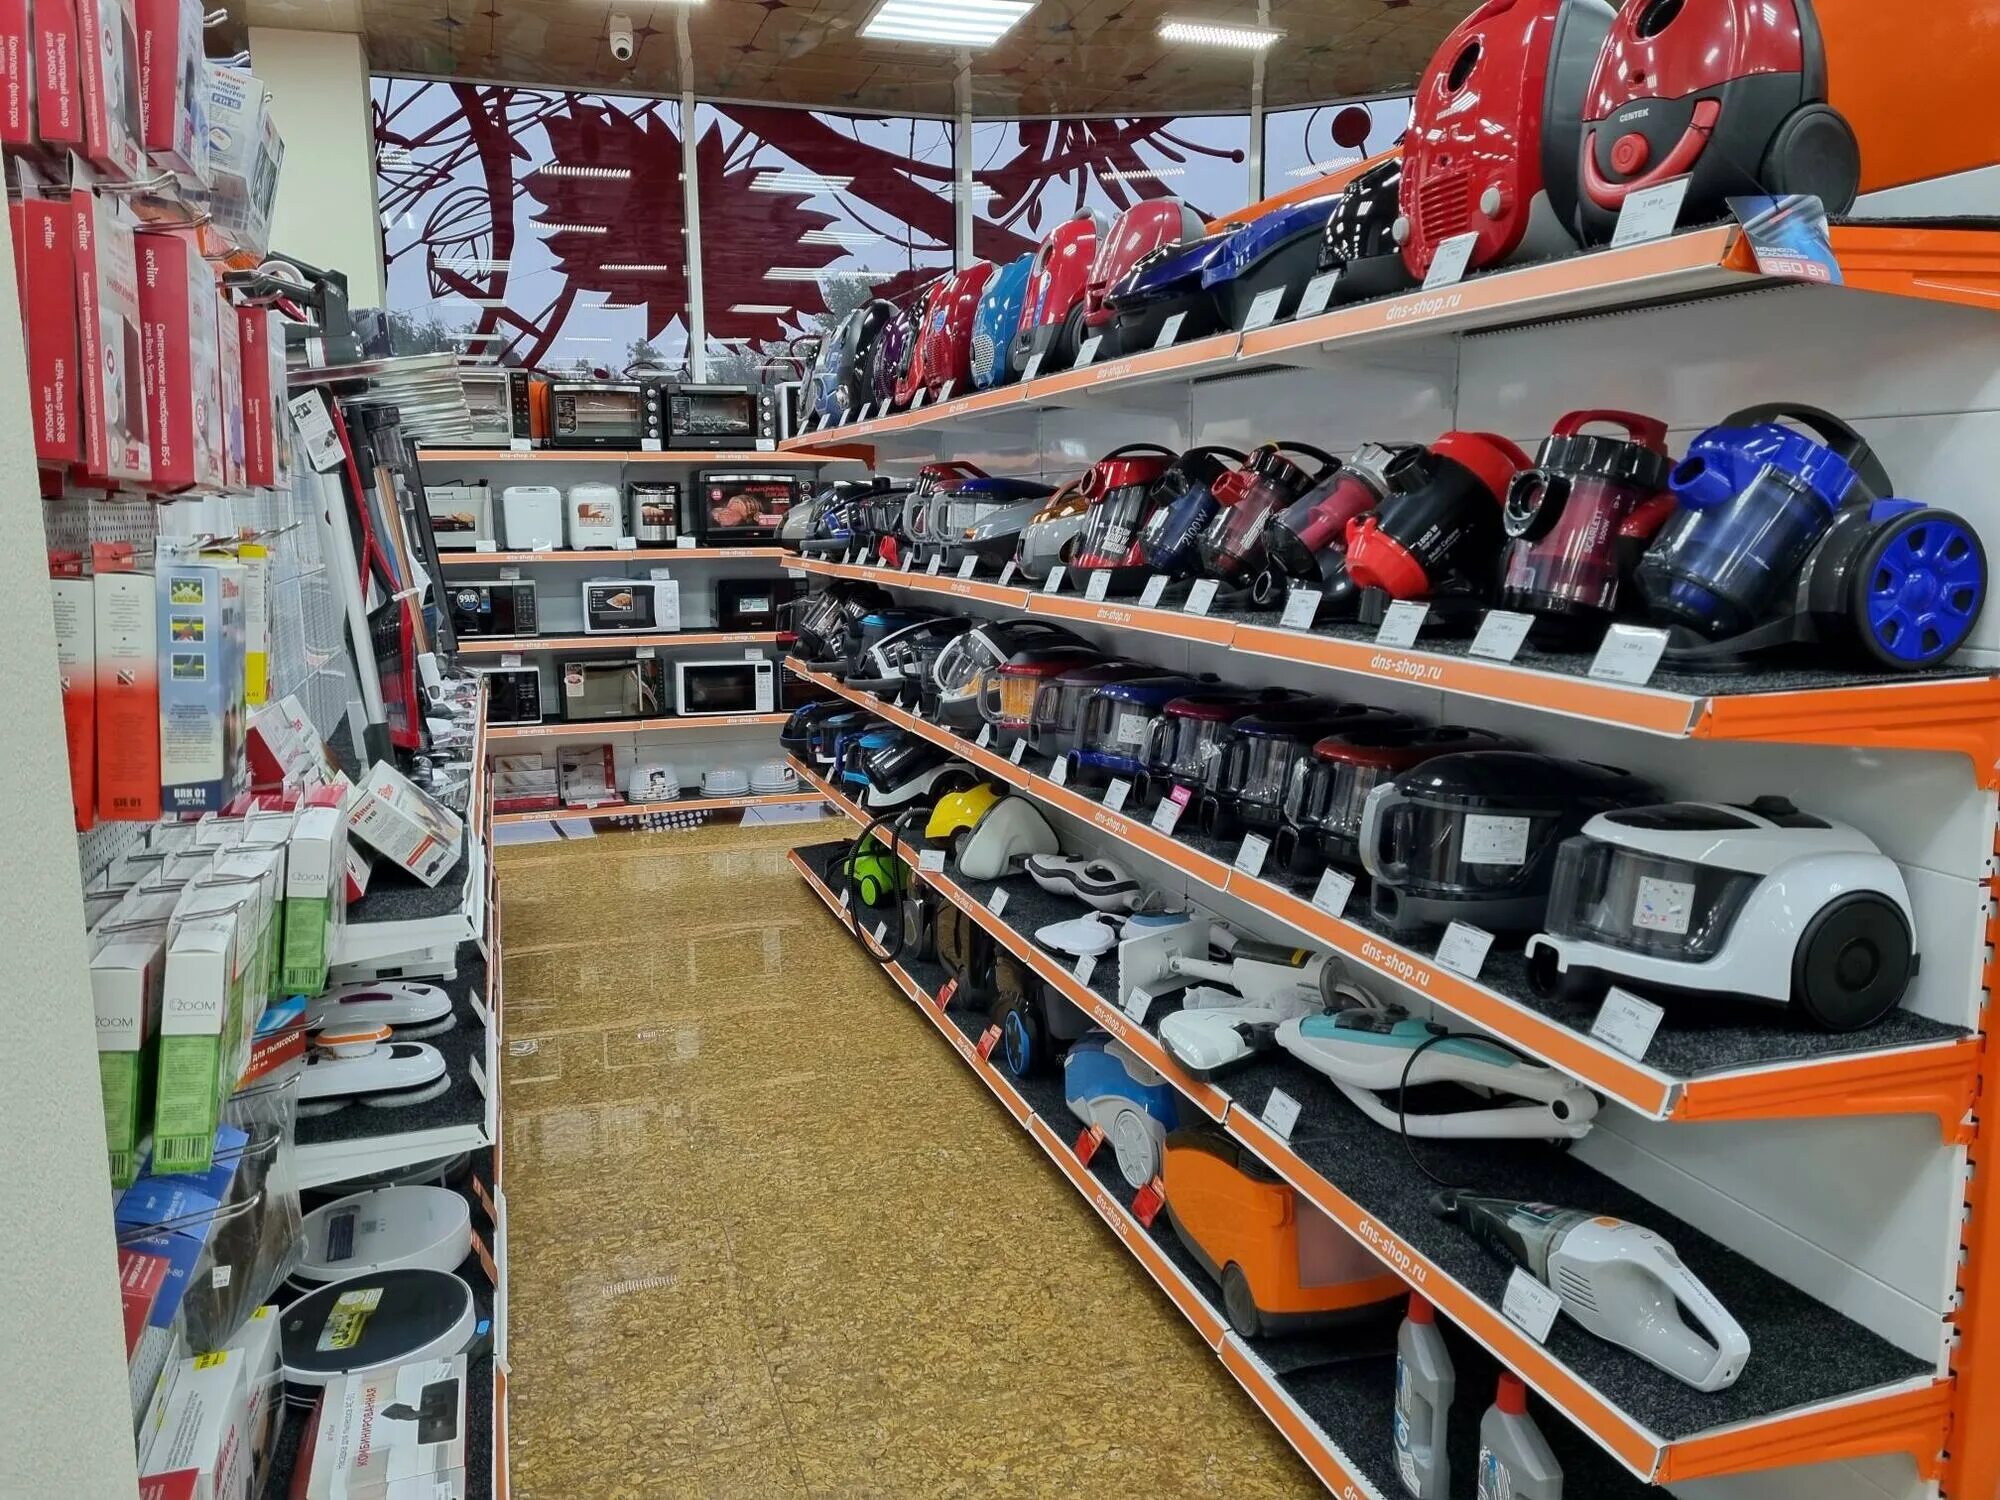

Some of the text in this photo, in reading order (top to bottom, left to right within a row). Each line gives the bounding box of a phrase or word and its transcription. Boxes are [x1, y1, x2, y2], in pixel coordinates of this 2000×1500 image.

[143, 30, 153, 65] Комплект
[8, 35, 19, 128] Комплект фильтров
[47, 48, 58, 89] SAMSUNG
[59, 96, 70, 128] фильтр
[1619, 108, 1649, 122] CENTEK
[43, 215, 55, 249] aceline
[77, 212, 91, 250] aceline
[146, 248, 159, 288] aceline
[1807, 264, 1826, 277] Вт
[1386, 294, 1462, 321] dns-shop.ru
[156, 323, 167, 385] Синтетические
[146, 363, 156, 396] Siemens
[45, 403, 54, 443] SAMSUNG
[1584, 510, 1603, 554] SCARLETT
[1096, 607, 1132, 623] dns-shop.ru
[1371, 653, 1442, 681] dns-shop.ru
[1094, 811, 1128, 835] dns-shop.ru
[1361, 940, 1431, 987] dns-shop.ru
[1094, 1004, 1128, 1037] dns-shop.ru
[1096, 1192, 1129, 1235] dns-shop.ru
[1358, 1217, 1428, 1284] dns-shop.ru
[356, 1386, 377, 1468] КОМБИНИРОВАННАЯ
